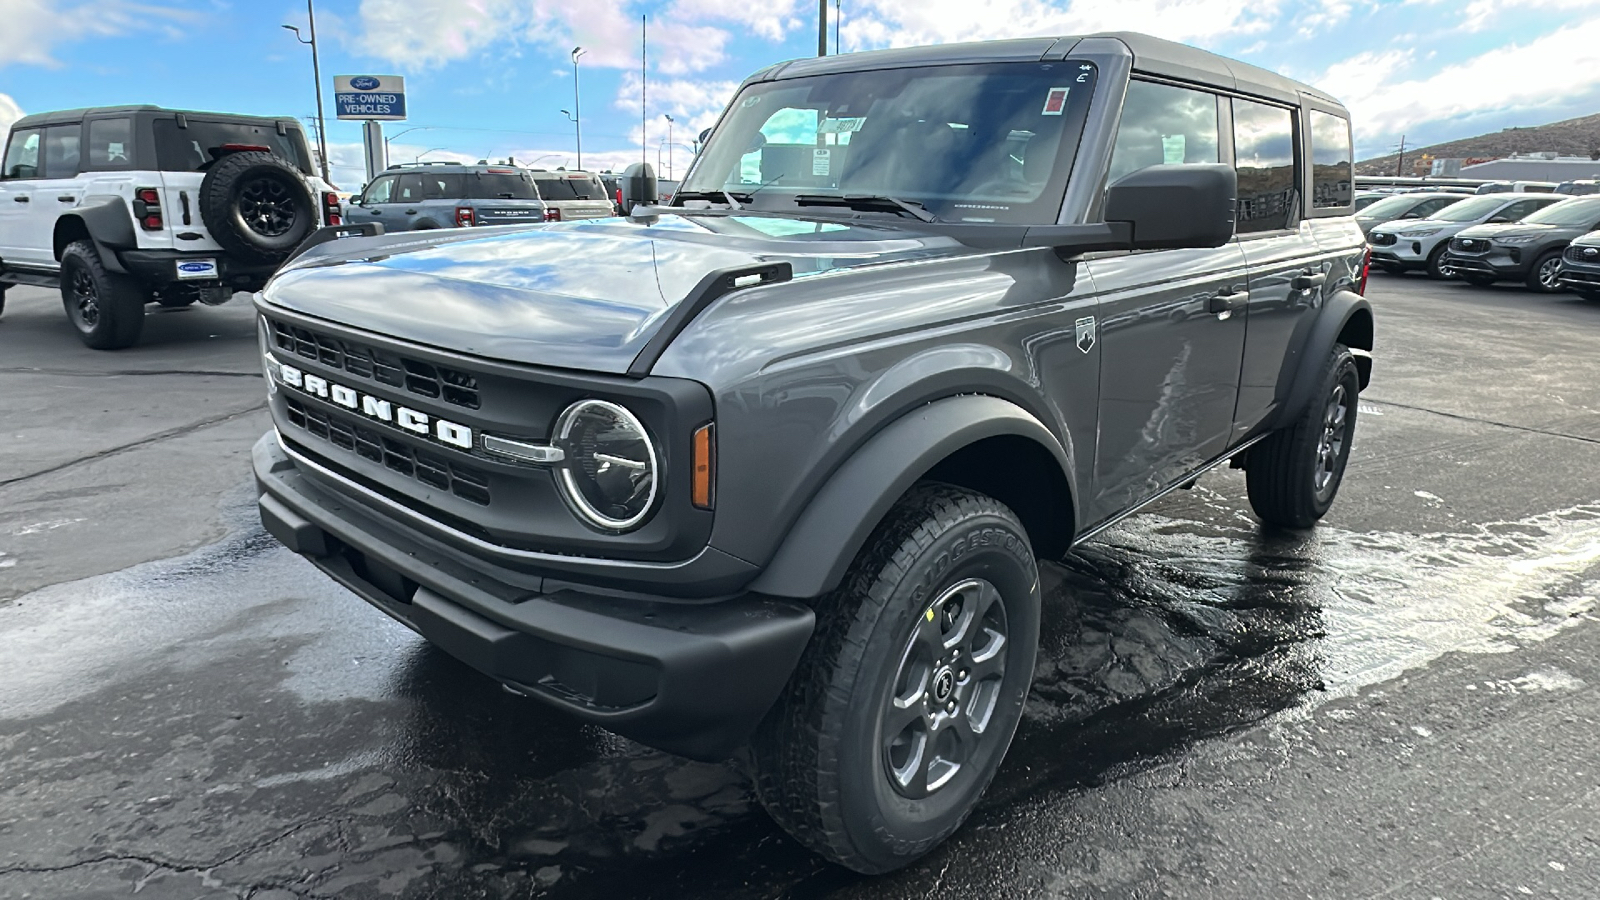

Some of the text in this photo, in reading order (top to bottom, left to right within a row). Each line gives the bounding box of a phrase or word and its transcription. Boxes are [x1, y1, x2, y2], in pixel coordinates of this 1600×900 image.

[355, 78, 373, 88] Ford
[338, 94, 397, 104] PRE-OWNED
[344, 104, 391, 114] VEHICLES
[281, 364, 473, 449] BRONCO
